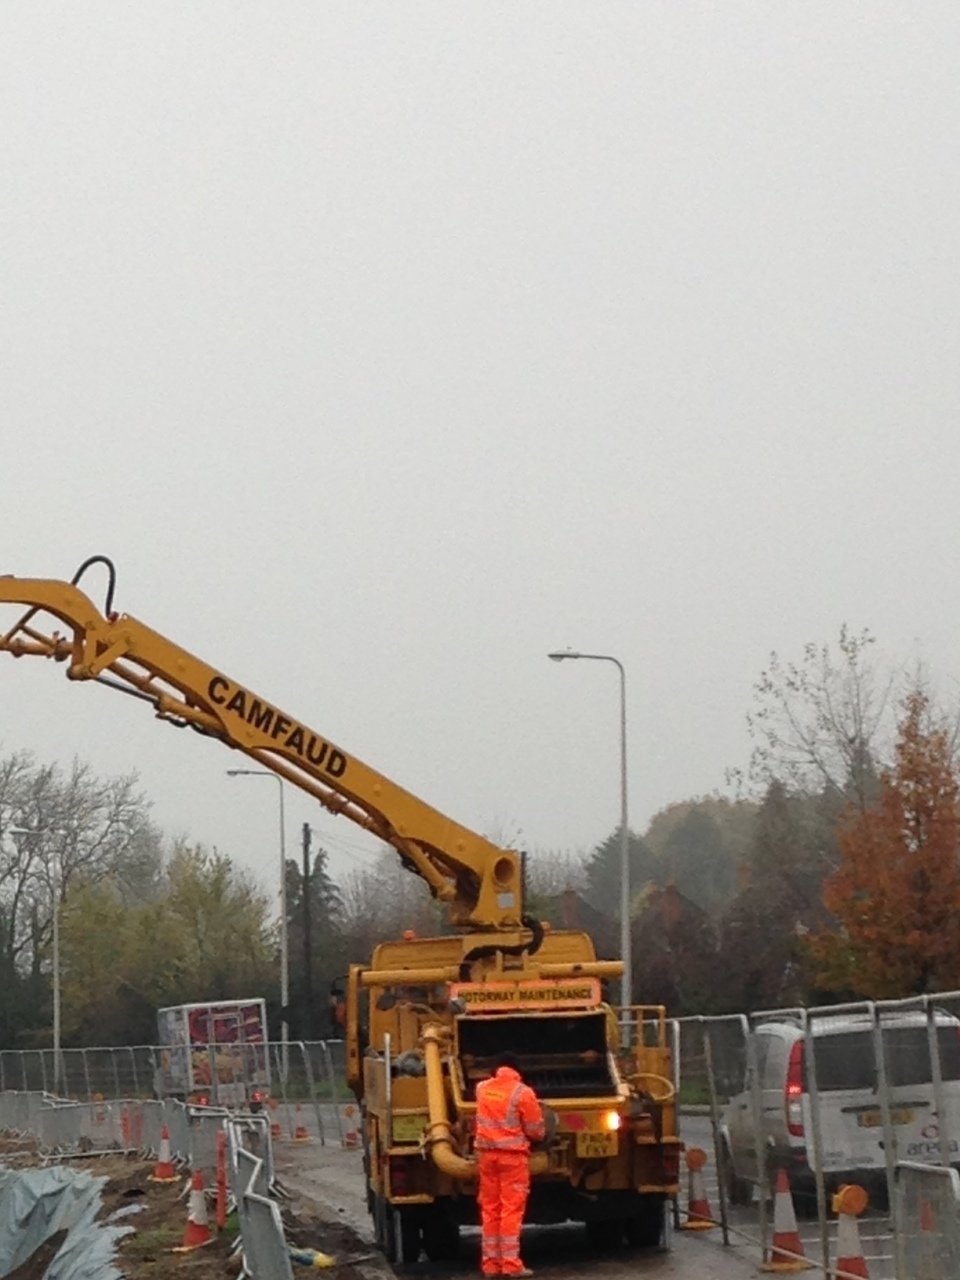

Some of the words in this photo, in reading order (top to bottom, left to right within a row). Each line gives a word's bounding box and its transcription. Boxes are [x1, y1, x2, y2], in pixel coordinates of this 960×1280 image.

[208, 676, 347, 778] CAMFAUD
[457, 990, 515, 1003] MOTORWAY
[519, 988, 592, 1001] MAINTENANCE
